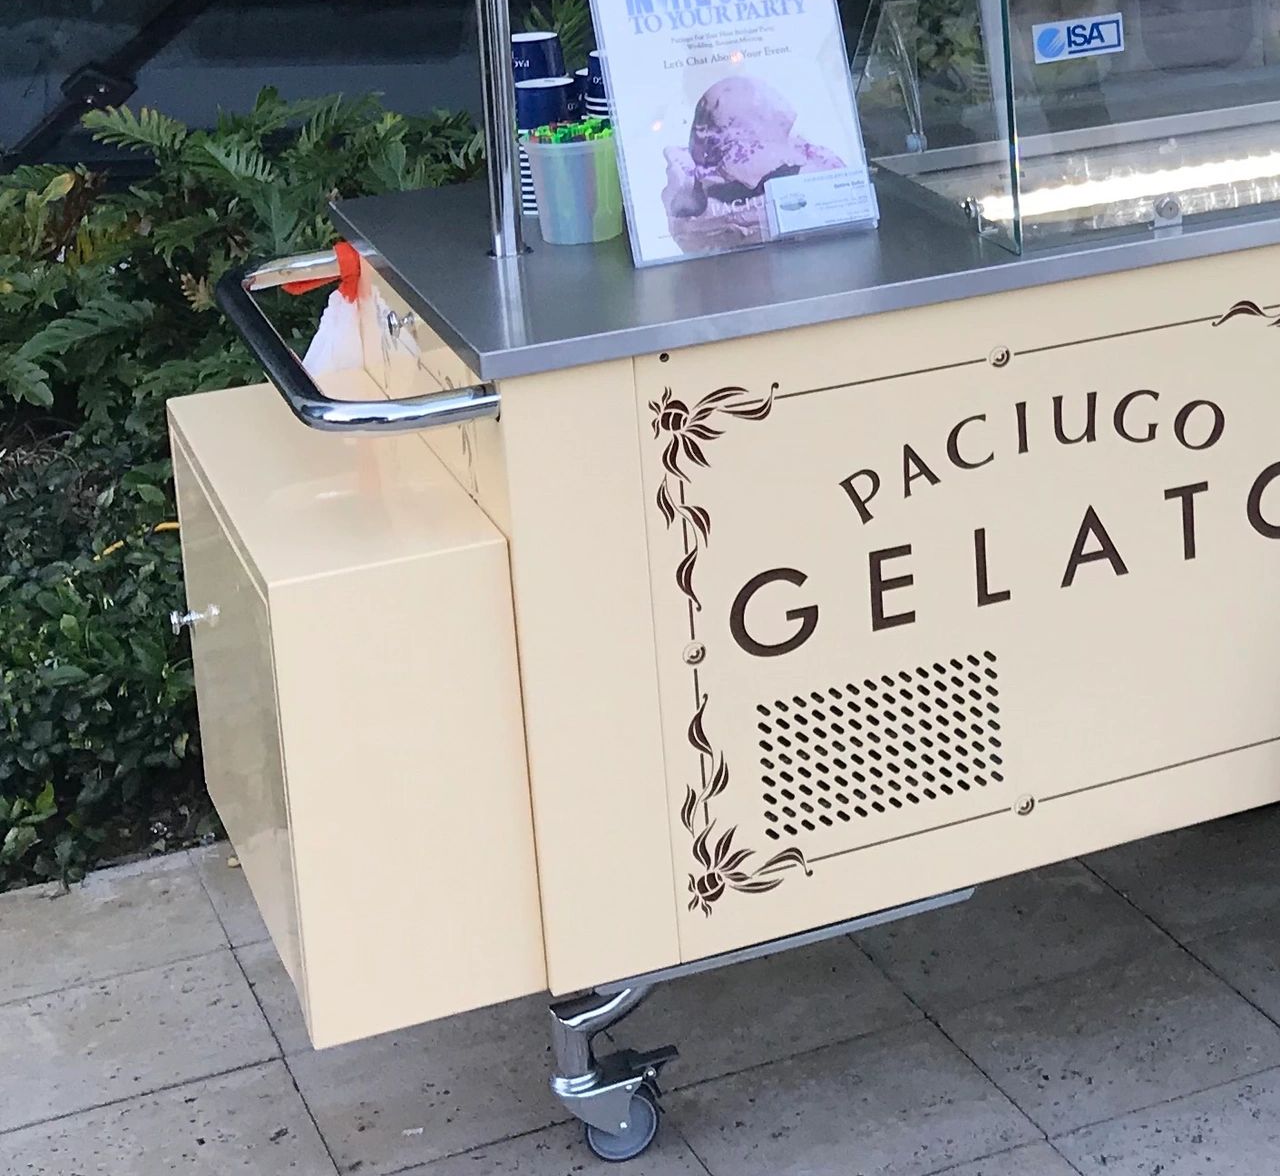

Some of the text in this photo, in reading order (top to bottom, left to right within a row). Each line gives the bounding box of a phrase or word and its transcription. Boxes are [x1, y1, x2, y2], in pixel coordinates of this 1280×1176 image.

[628, 14, 662, 35] TO
[665, 4, 733, 30] YOUR
[1066, 23, 1105, 48] ISA
[686, 54, 708, 66] Chat
[838, 389, 1226, 524] PACIUGO
